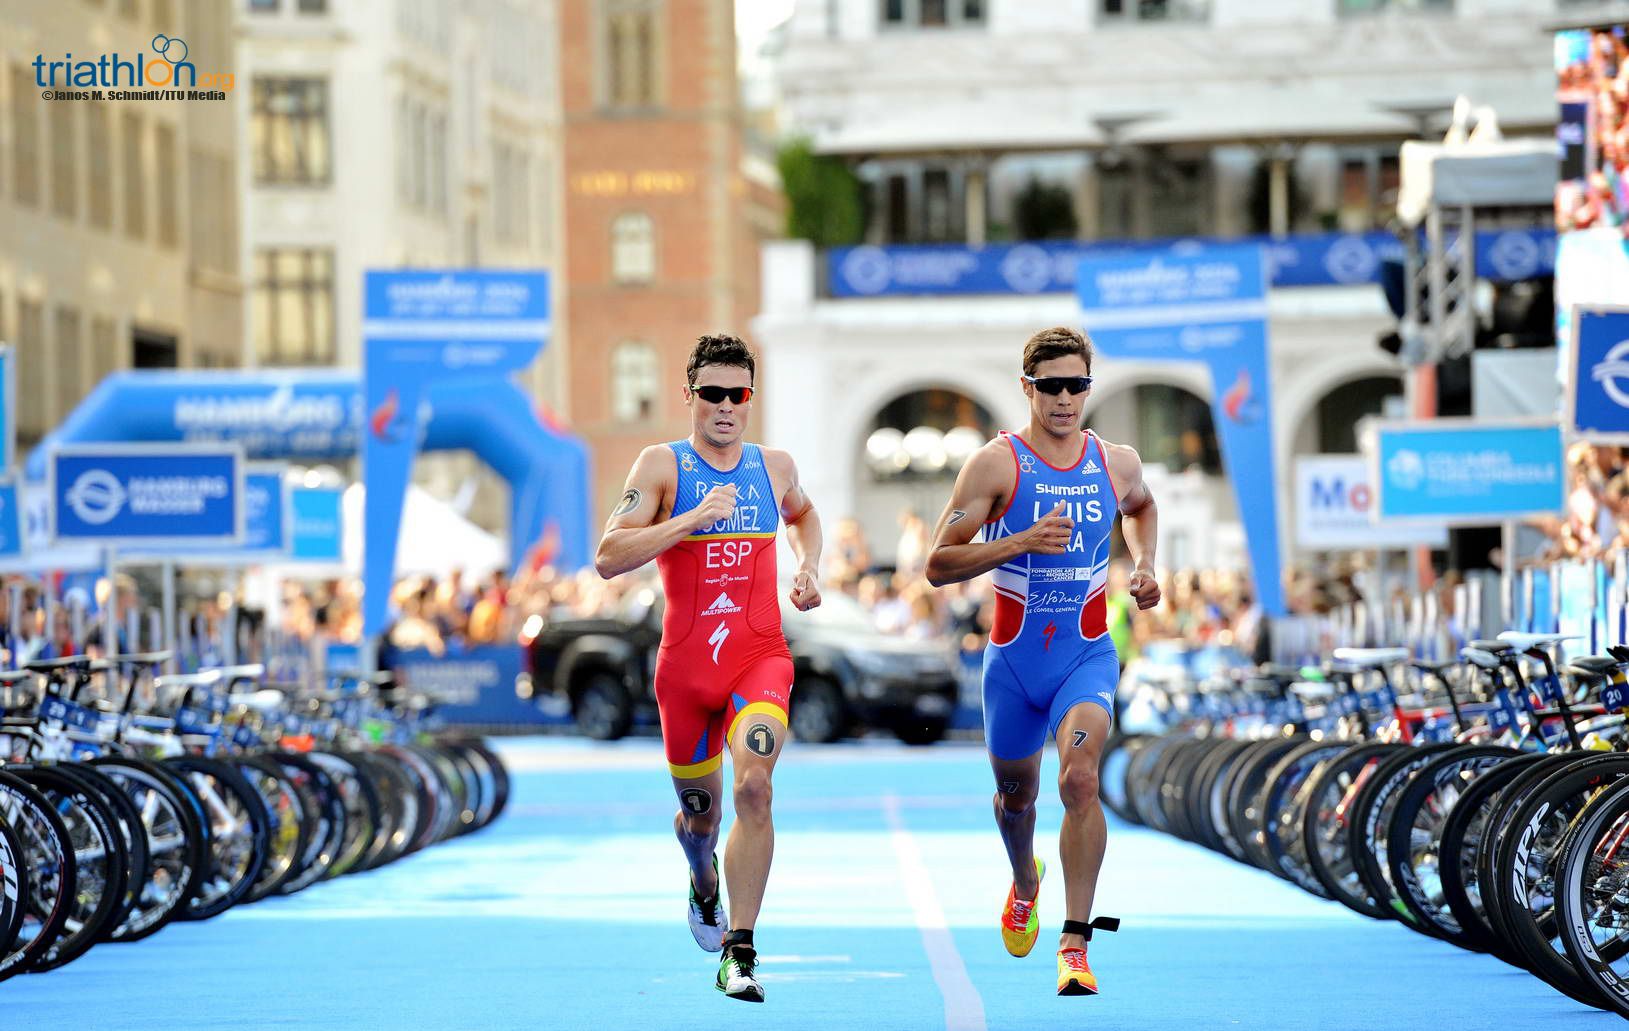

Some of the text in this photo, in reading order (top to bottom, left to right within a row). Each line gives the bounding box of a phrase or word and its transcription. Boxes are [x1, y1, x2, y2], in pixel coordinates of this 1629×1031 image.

[1081, 467, 1101, 475] adidas
[1035, 484, 1099, 496] SHIMANO
[703, 505, 761, 533] MEZ
[706, 541, 752, 569] ESP
[700, 606, 744, 616] MULTIPOWER
[1606, 689, 1623, 705] 20
[754, 731, 767, 753] 1
[1072, 730, 1089, 748] 7
[687, 795, 702, 811] 1
[1512, 801, 1550, 910] ZIPP
